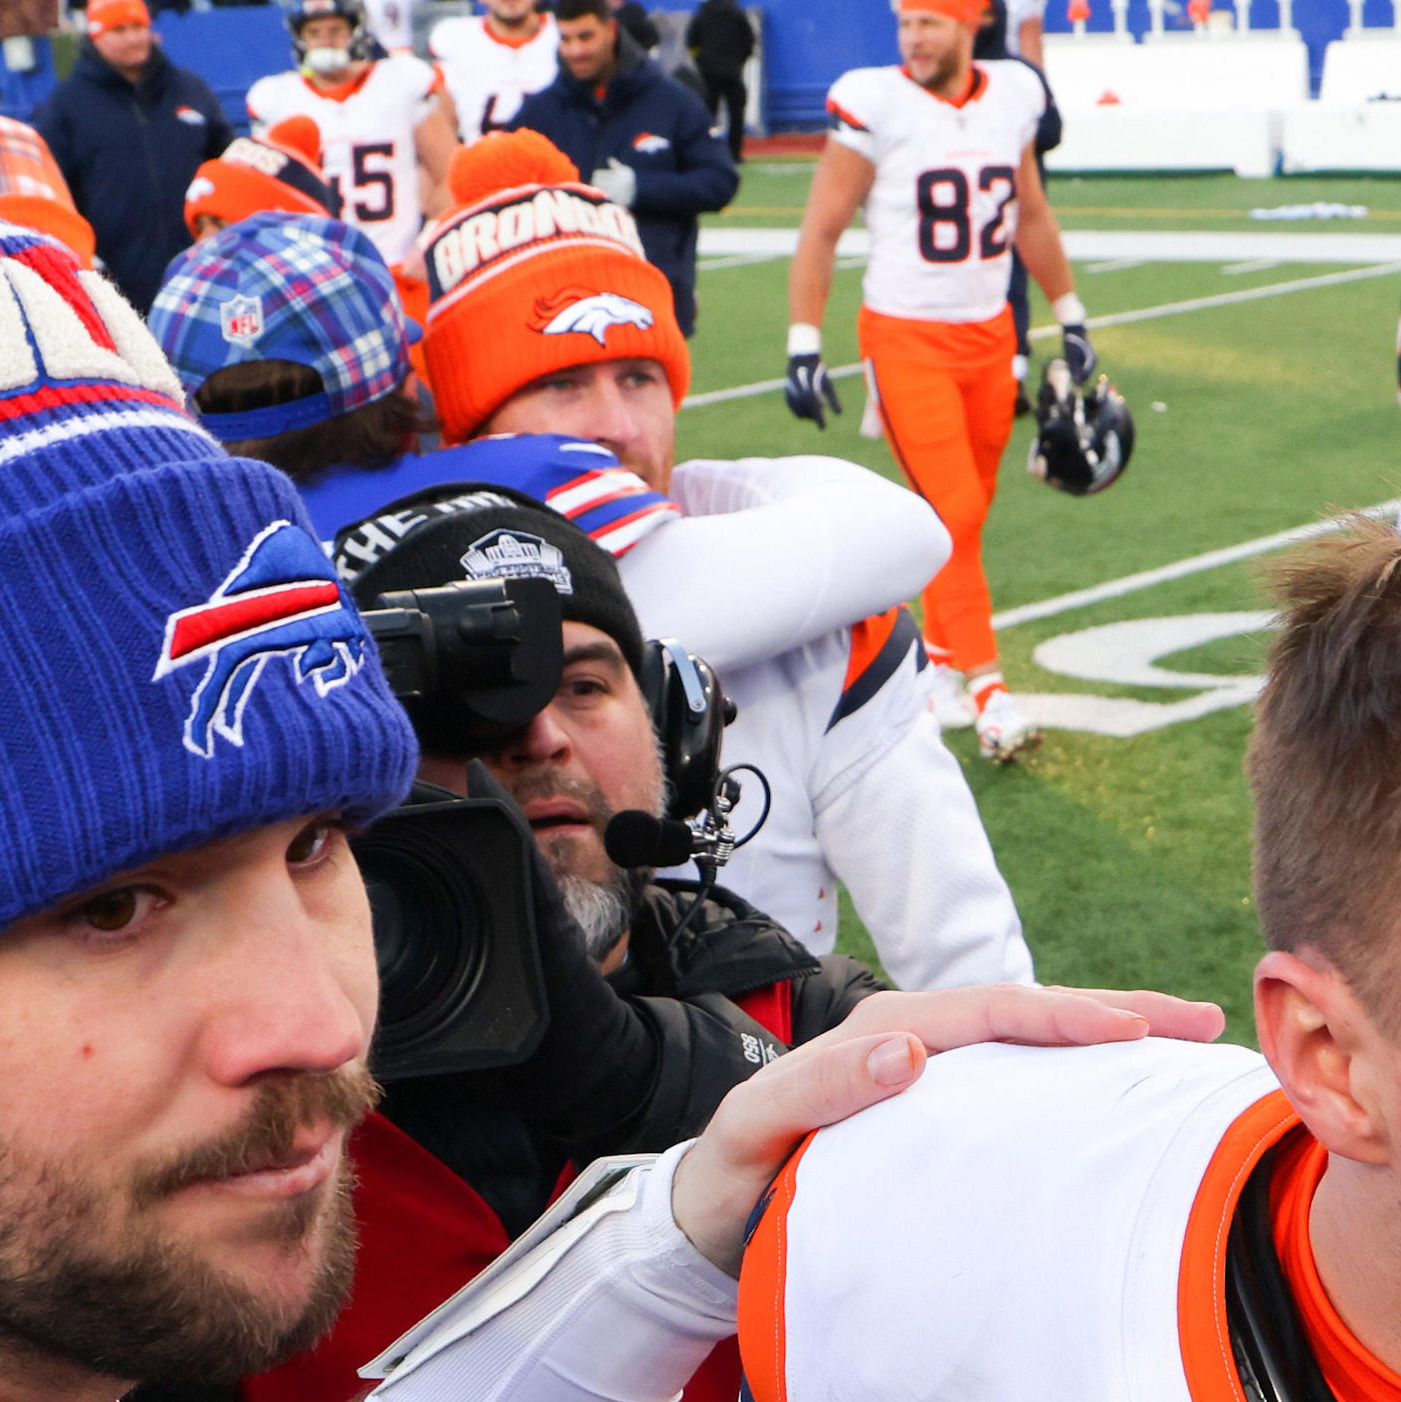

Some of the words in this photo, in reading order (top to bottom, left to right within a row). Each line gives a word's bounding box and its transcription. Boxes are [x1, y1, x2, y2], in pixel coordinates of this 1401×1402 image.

[433, 188, 647, 293] BRONCO
[918, 167, 1018, 264] 82
[230, 314, 260, 337] NFL
[740, 1032, 761, 1064] 850
